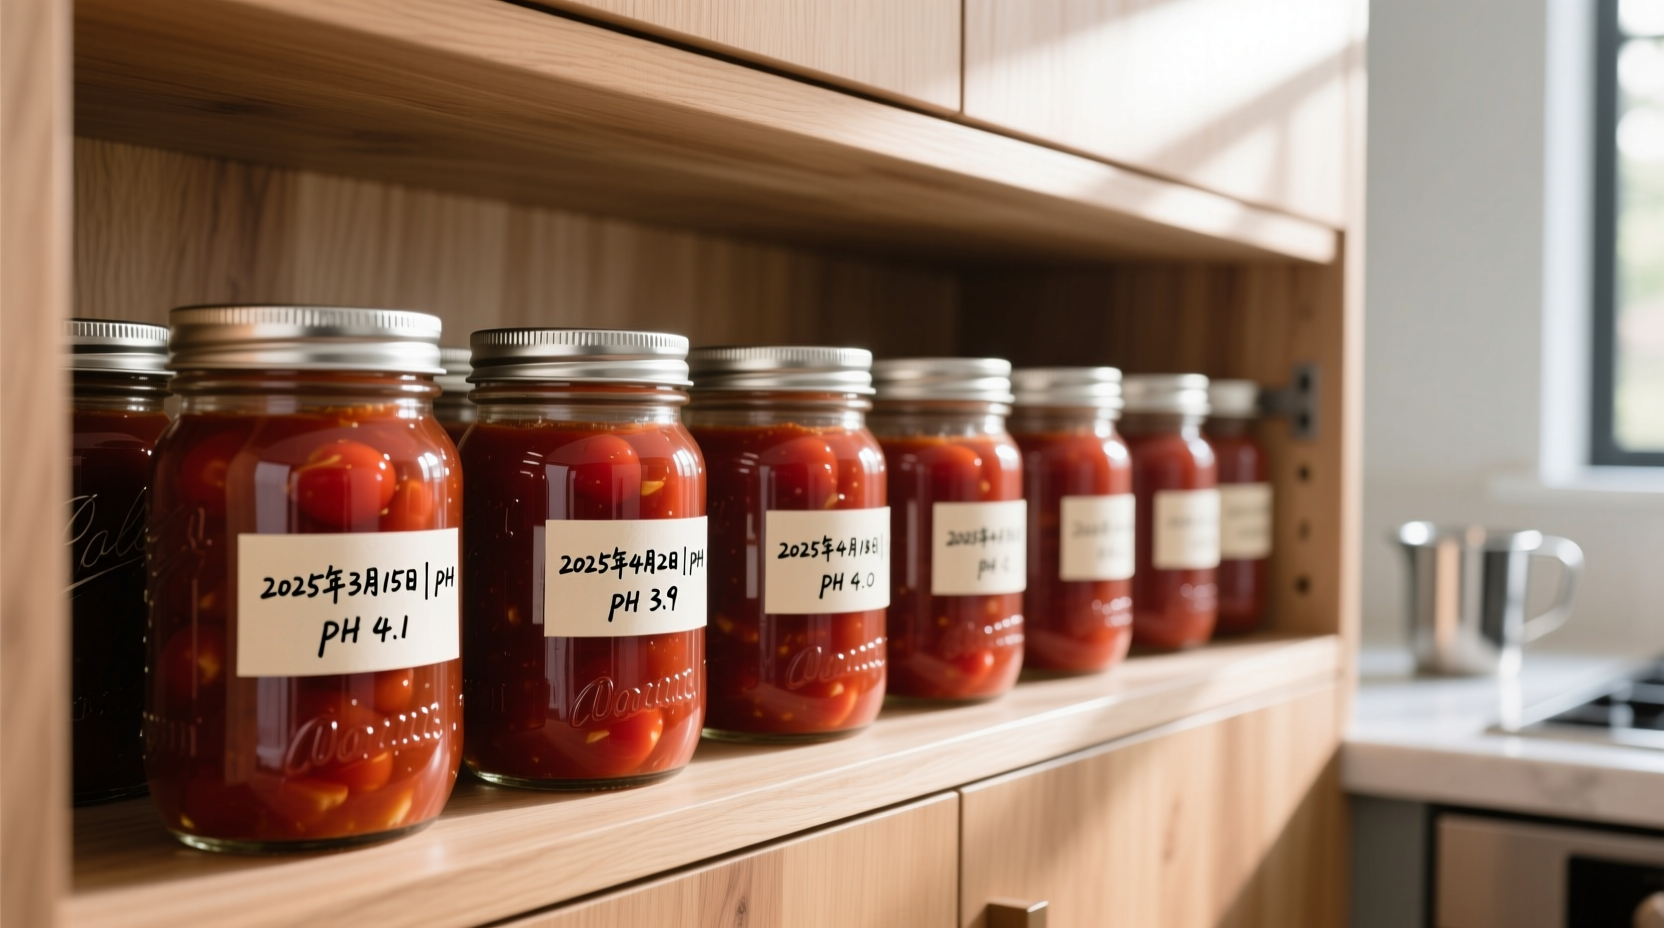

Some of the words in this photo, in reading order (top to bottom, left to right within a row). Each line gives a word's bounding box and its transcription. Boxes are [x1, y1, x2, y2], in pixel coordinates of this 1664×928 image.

[559, 547, 678, 579] 2025年4月2日
[260, 565, 417, 604] 2025年3月15日
[850, 572, 875, 591] 4.0
[649, 586, 678, 611] 3.9
[372, 615, 408, 643] 4.1
